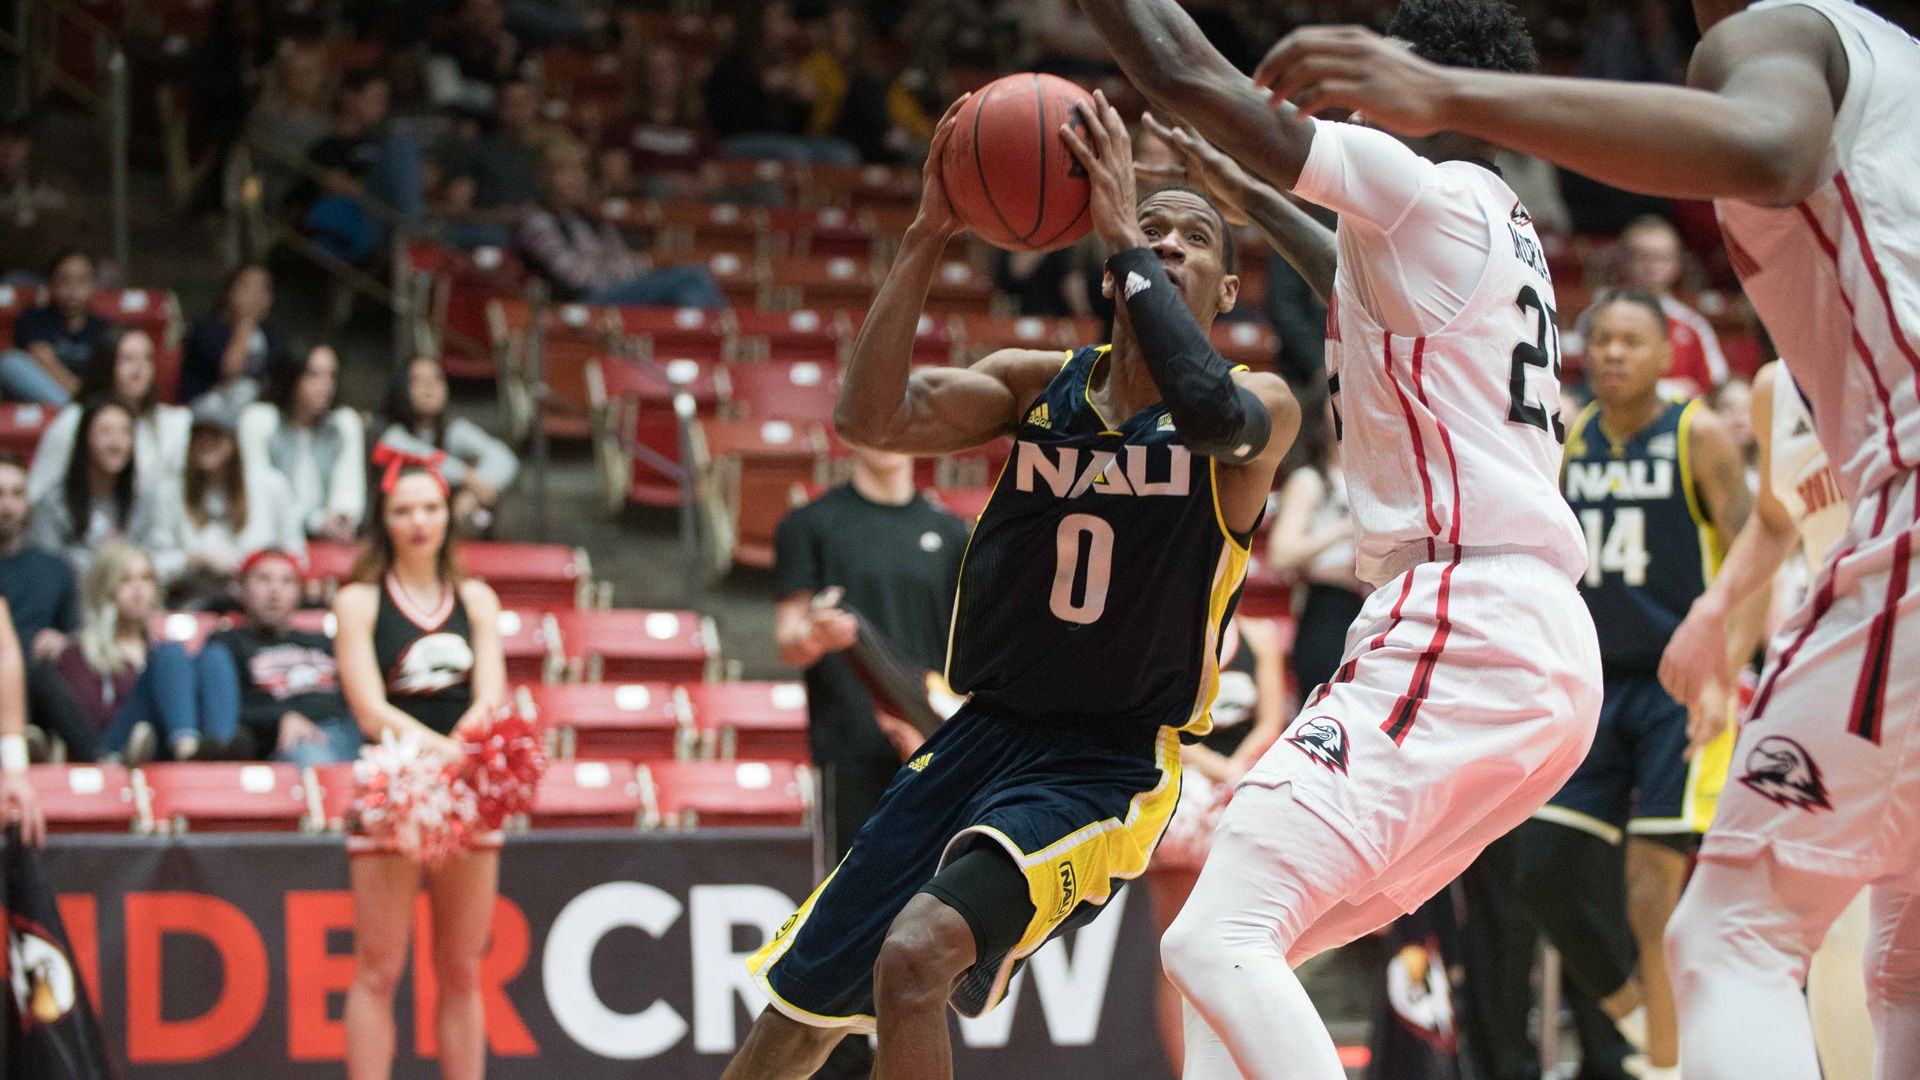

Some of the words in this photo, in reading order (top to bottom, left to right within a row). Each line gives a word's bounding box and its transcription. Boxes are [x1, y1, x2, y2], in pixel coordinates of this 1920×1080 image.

[1016, 440, 1191, 499] NAU
[1566, 459, 1674, 502] NAU
[1049, 513, 1115, 625] 0
[1579, 507, 1651, 588] 14
